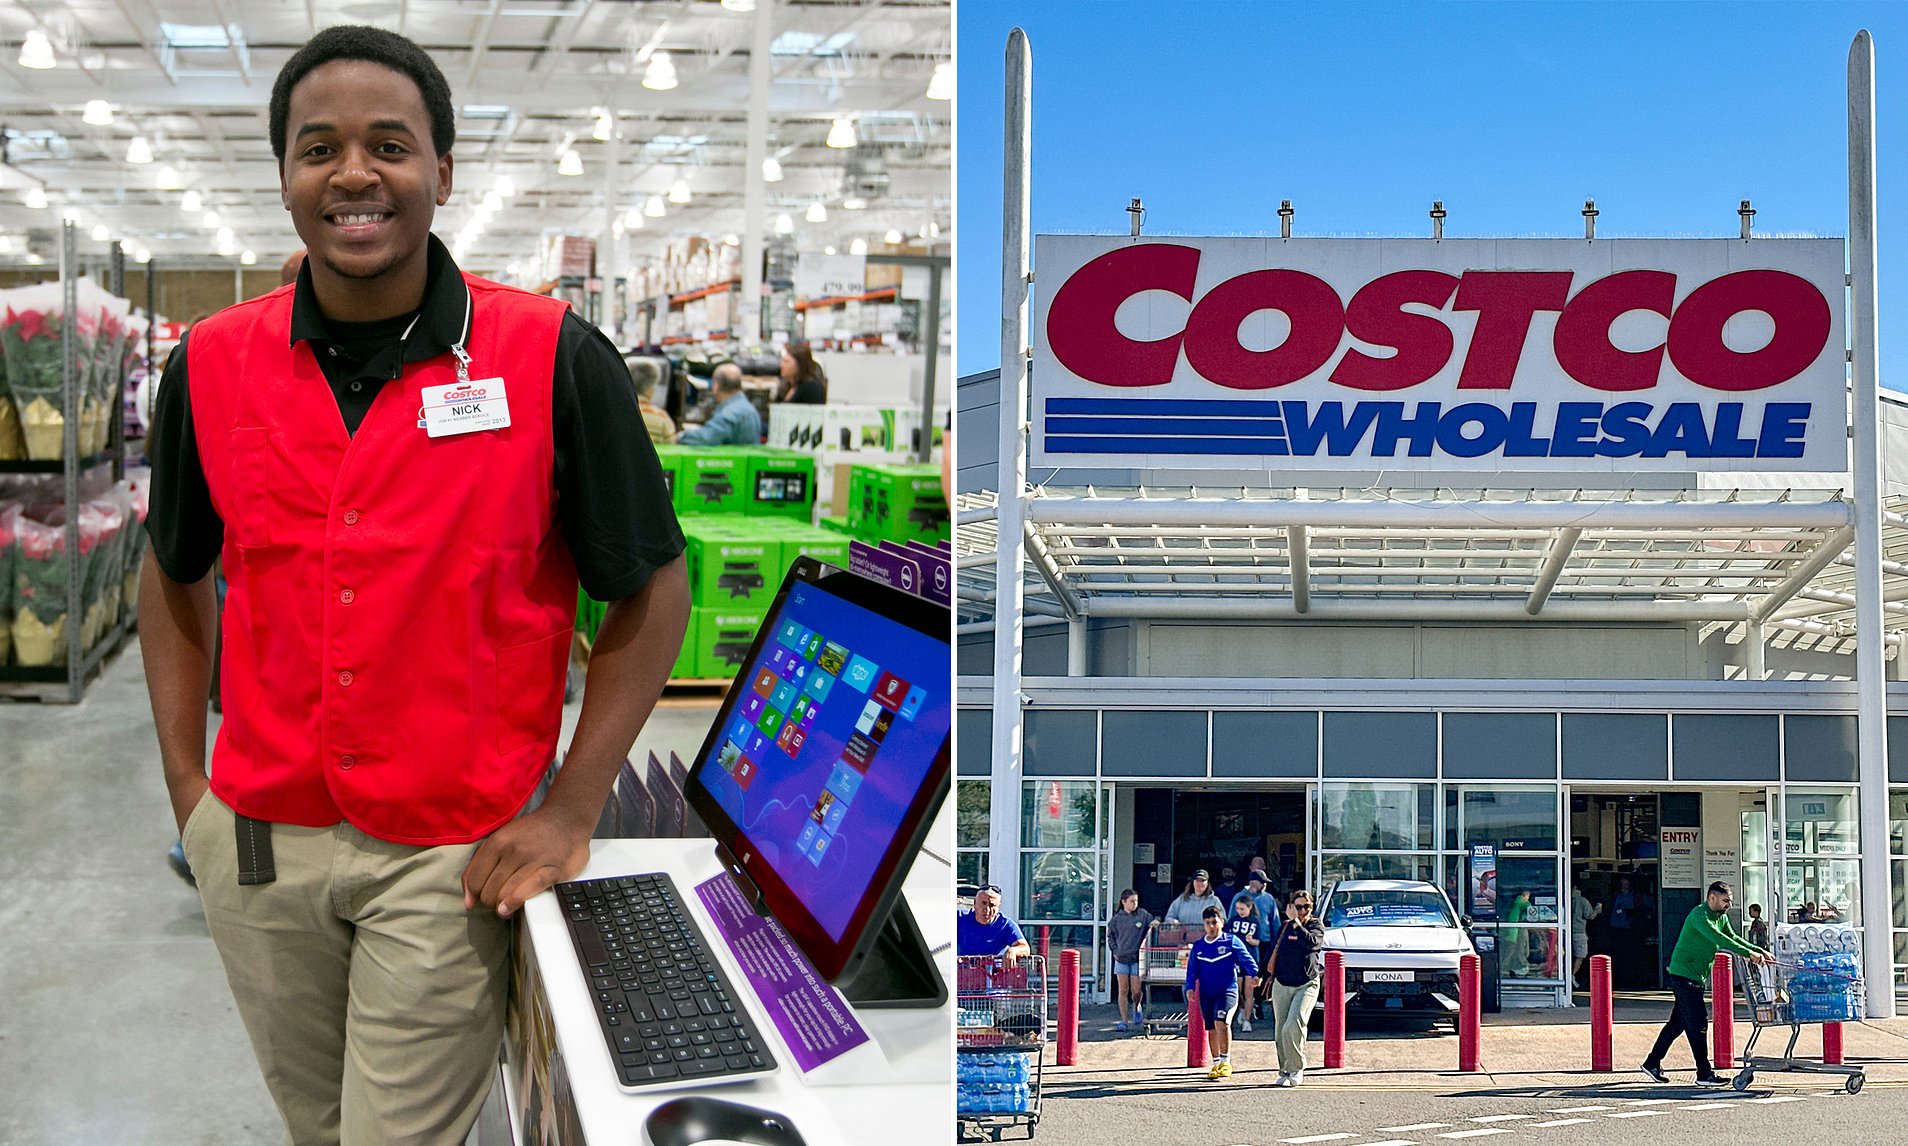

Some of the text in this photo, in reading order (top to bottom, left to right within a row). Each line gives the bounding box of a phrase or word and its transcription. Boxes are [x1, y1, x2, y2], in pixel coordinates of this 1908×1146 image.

[1047, 243, 1831, 392] COSTCO
[443, 388, 486, 400] COSTCO
[452, 404, 482, 416] NICK
[1284, 402, 1811, 458] WHOLESALE
[1662, 832, 1698, 843] ENTRY
[1347, 908, 1374, 916] AUTO
[1375, 973, 1403, 981] KONA
